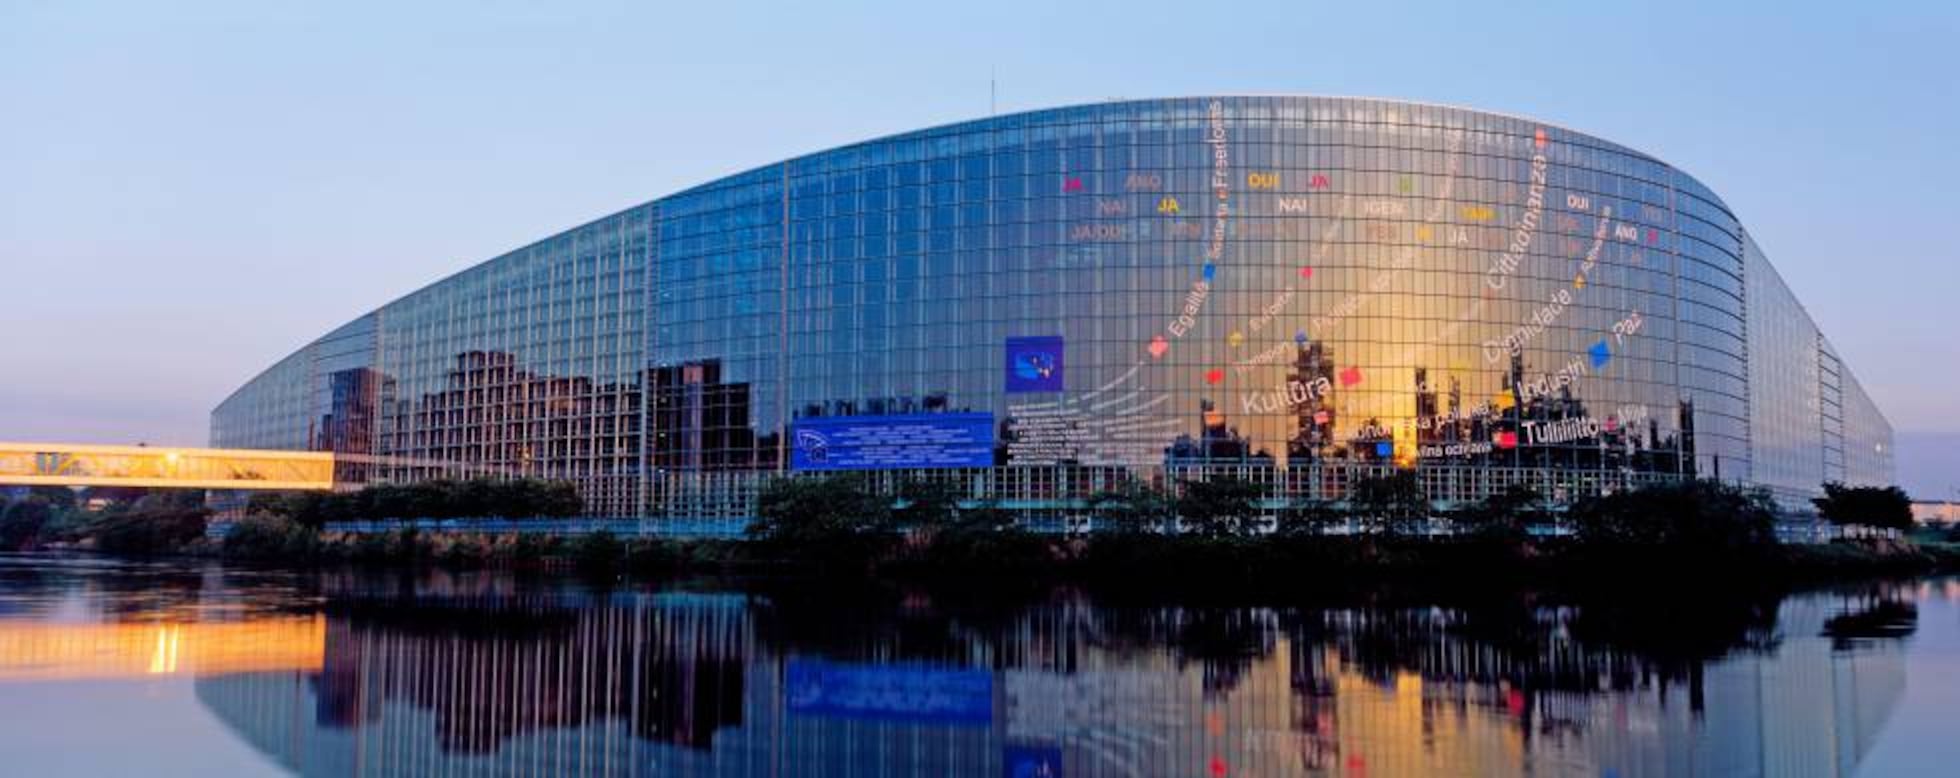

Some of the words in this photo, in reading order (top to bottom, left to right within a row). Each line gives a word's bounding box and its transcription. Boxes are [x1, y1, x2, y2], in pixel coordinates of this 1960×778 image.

[1248, 172, 1280, 190] OUI
[1309, 174, 1329, 189] JA
[1157, 196, 1180, 213] JA
[1278, 198, 1308, 213] NAI
[1567, 194, 1589, 210] OUI
[1484, 287, 1572, 363] Dignidade
[1242, 375, 1331, 415] Kultūra
